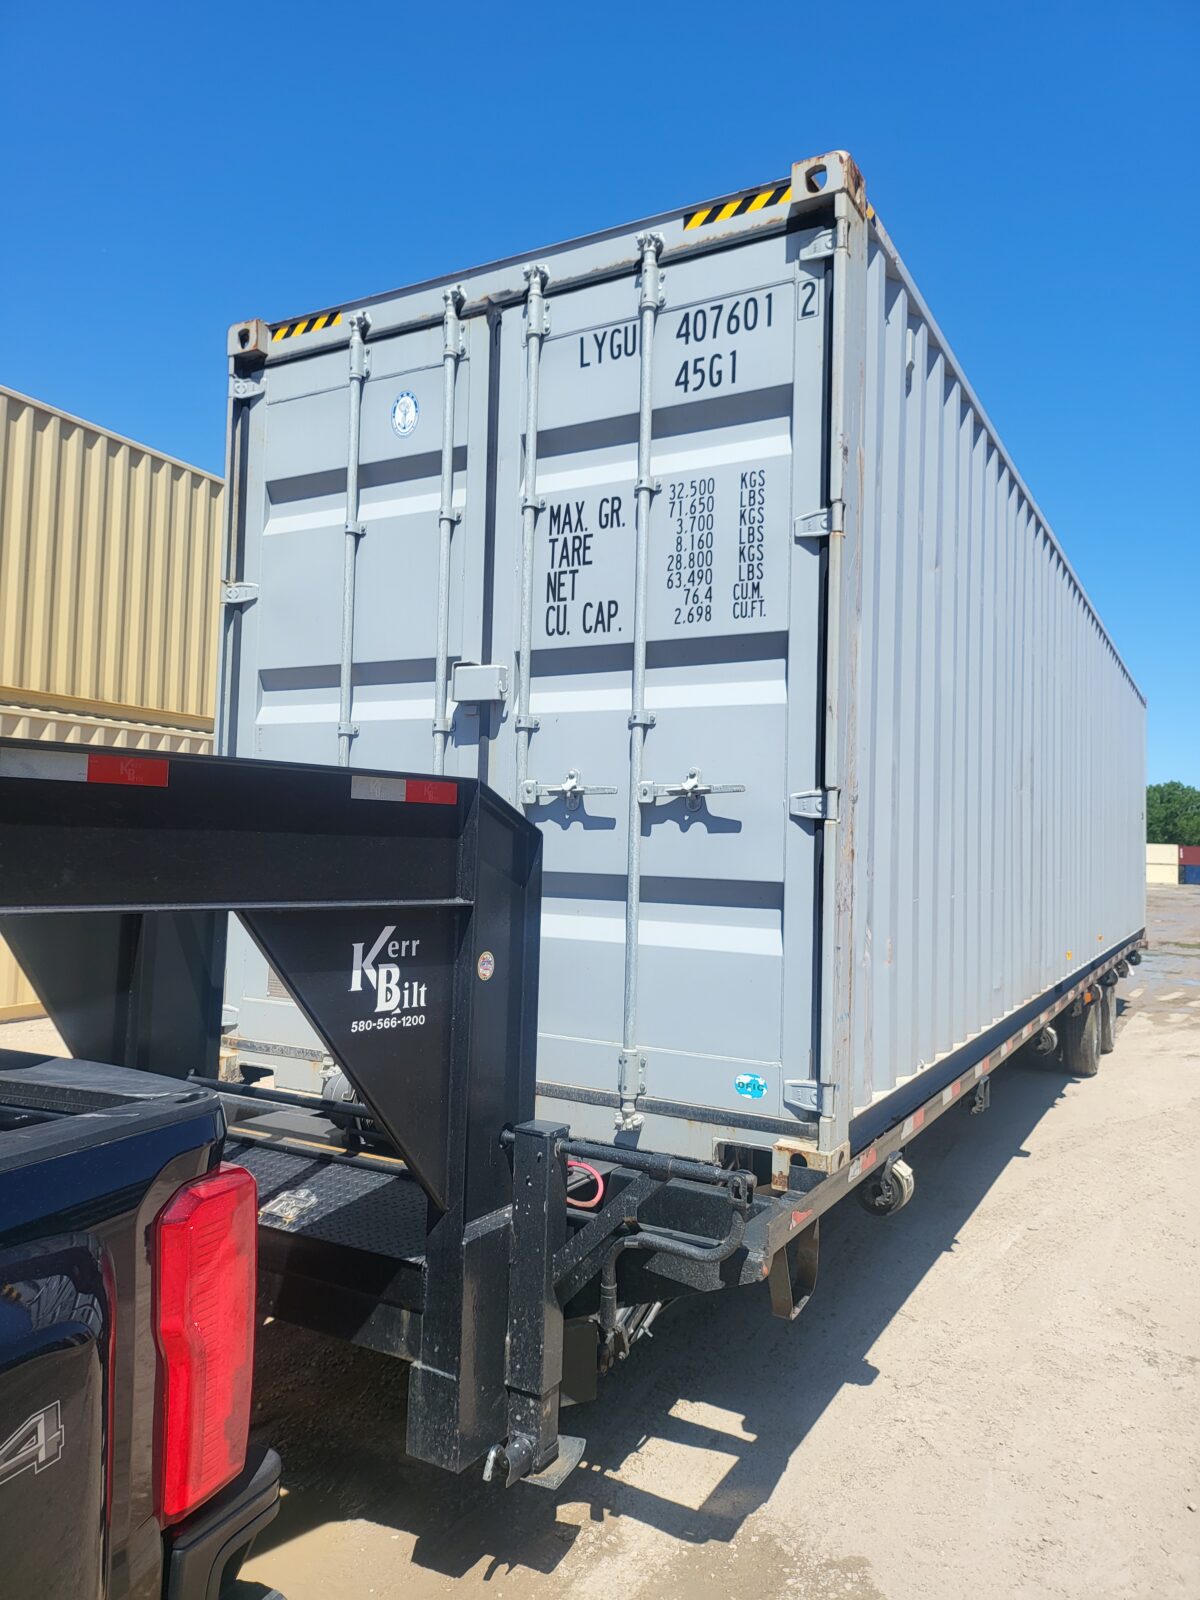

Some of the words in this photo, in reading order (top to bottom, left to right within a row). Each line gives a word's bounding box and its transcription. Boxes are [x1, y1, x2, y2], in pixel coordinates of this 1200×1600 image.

[579, 324, 637, 368] LYGU
[676, 292, 774, 345] 407601
[801, 281, 817, 318] 2
[674, 350, 737, 393] 45G1
[741, 469, 765, 490] KGS
[740, 488, 765, 508] LBS
[549, 501, 588, 536] MAX.
[598, 496, 626, 529] GR.
[739, 506, 764, 527] KGS
[739, 525, 764, 545] LBS
[549, 533, 593, 569] TARE
[739, 543, 764, 563] KGS
[739, 562, 764, 582] LBS
[546, 569, 579, 603] NET
[683, 585, 713, 606] 76.4
[545, 604, 570, 636] CU.
[582, 600, 622, 634] CAP.
[348, 925, 420, 992] Kerr
[374, 963, 427, 1015] Bilt
[350, 1014, 426, 1033] 580-566-1200
